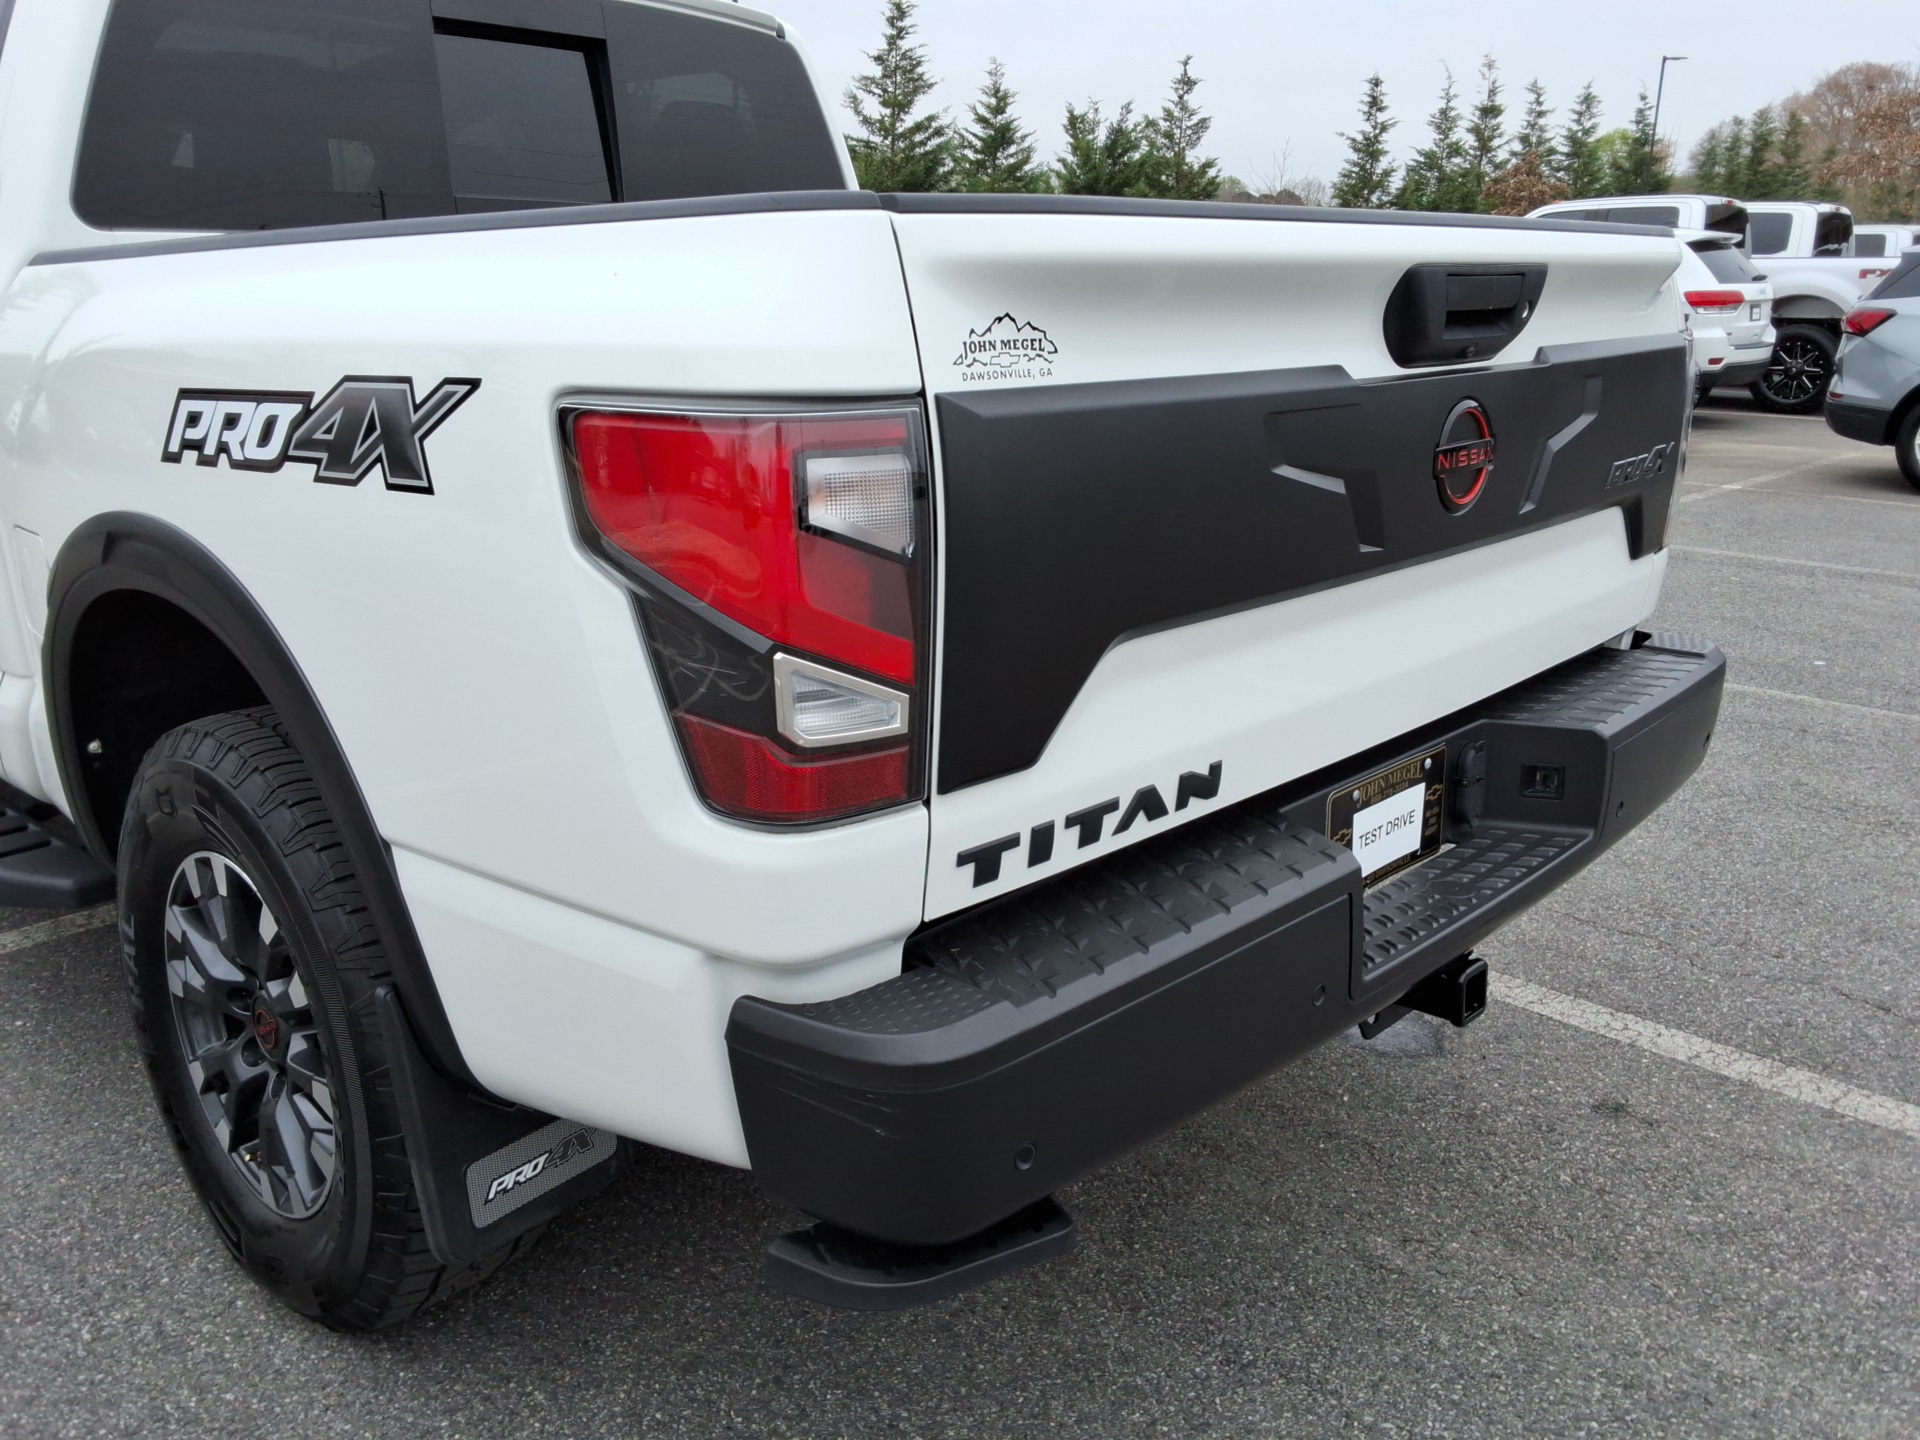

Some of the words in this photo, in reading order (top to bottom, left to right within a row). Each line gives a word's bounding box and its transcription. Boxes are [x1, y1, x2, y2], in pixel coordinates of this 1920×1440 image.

[962, 339, 997, 361] JOHN
[1000, 338, 1045, 352] MEGEL
[962, 368, 1035, 382] DAWSONVILLE,
[1039, 367, 1053, 377] GA
[1437, 444, 1494, 470] NISSAN
[1356, 775, 1388, 809] JOHN
[1387, 761, 1423, 788] MEGEL
[956, 759, 1222, 889] TITAN
[1358, 824, 1384, 850] TEST
[1385, 809, 1416, 836] DRIVE
